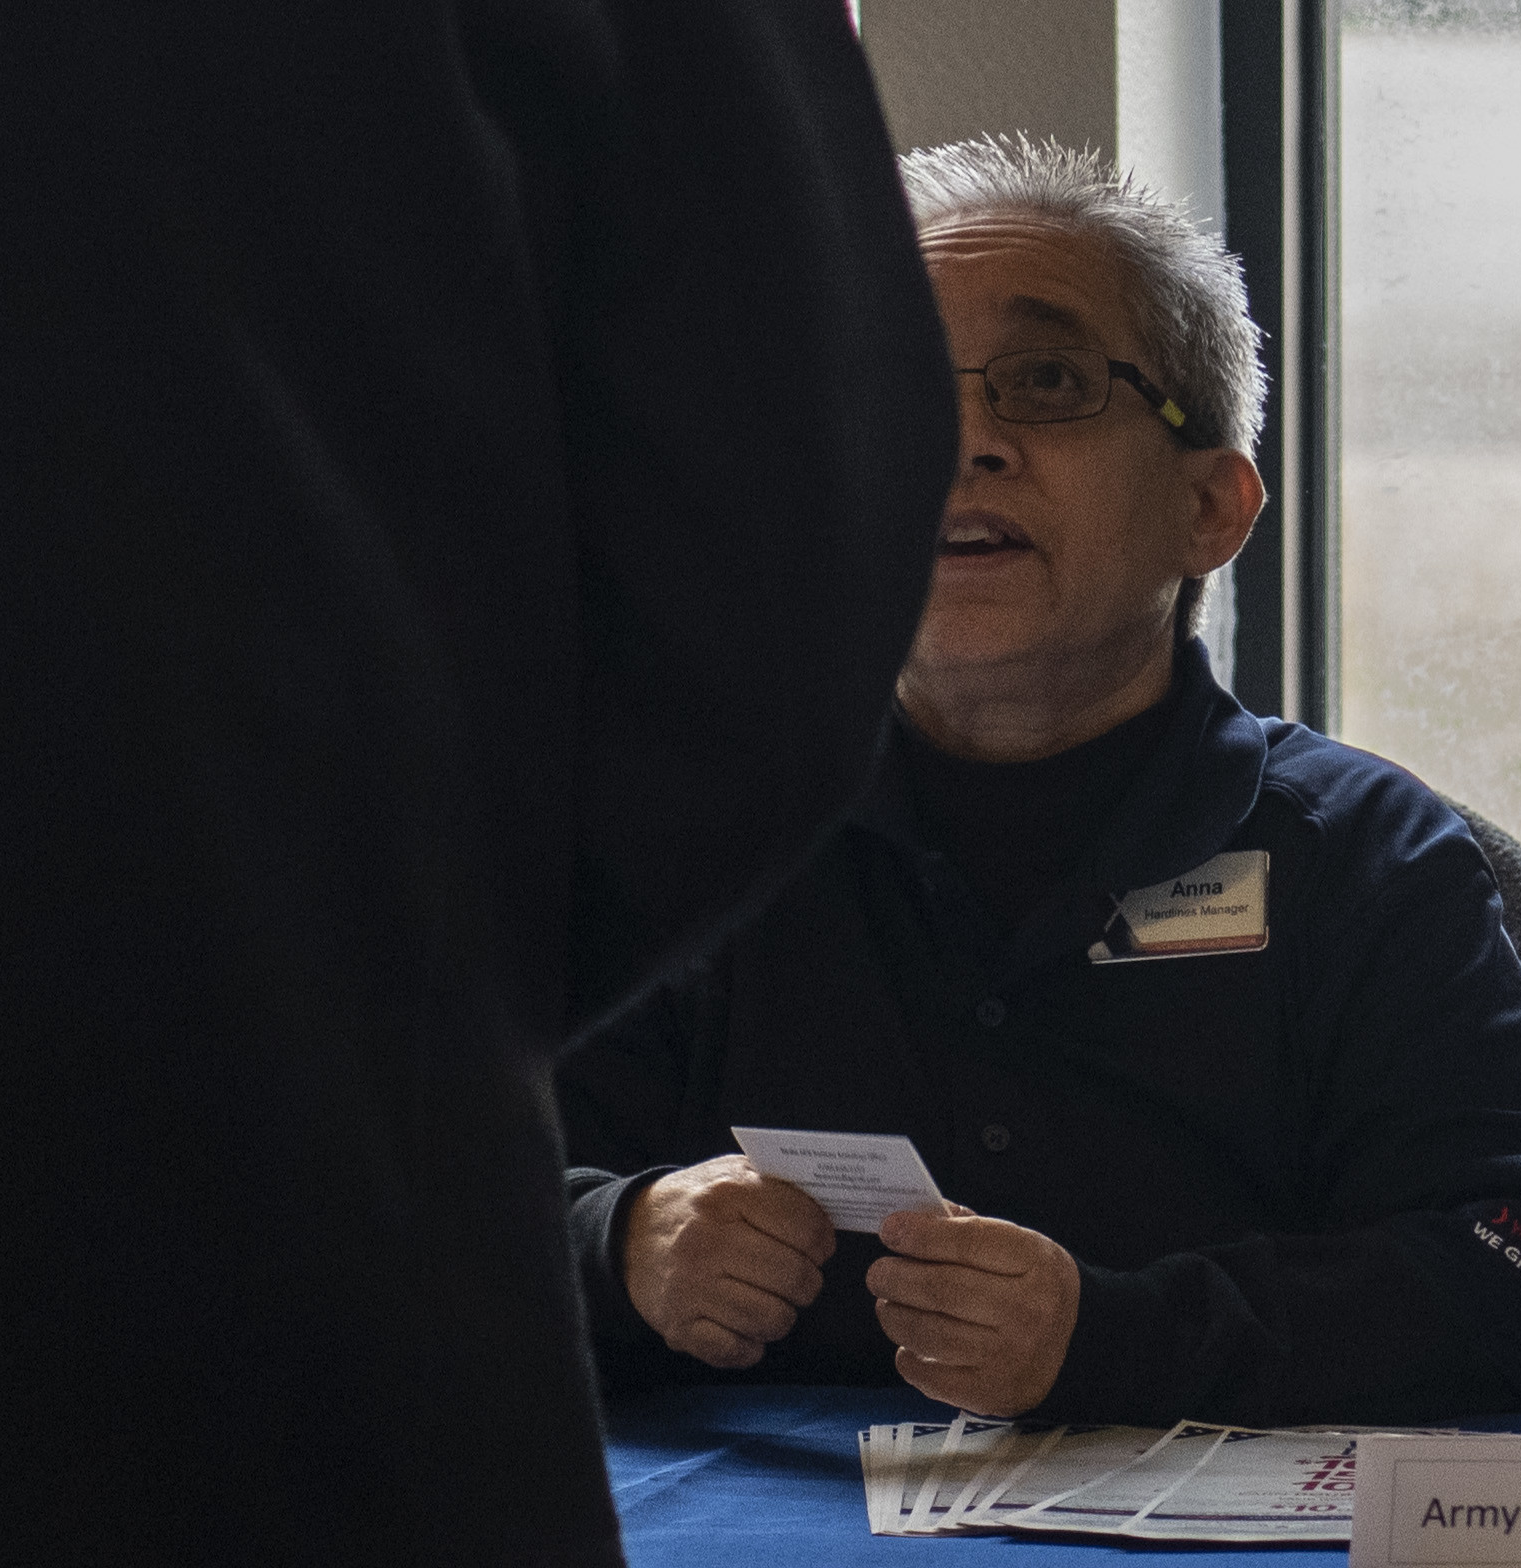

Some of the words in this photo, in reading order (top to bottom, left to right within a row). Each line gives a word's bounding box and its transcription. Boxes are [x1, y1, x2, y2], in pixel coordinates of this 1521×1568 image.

[1170, 882, 1223, 898] Anna
[1200, 903, 1250, 916] Manager
[1473, 1220, 1504, 1250] WE
[1421, 1496, 1521, 1534] Army
